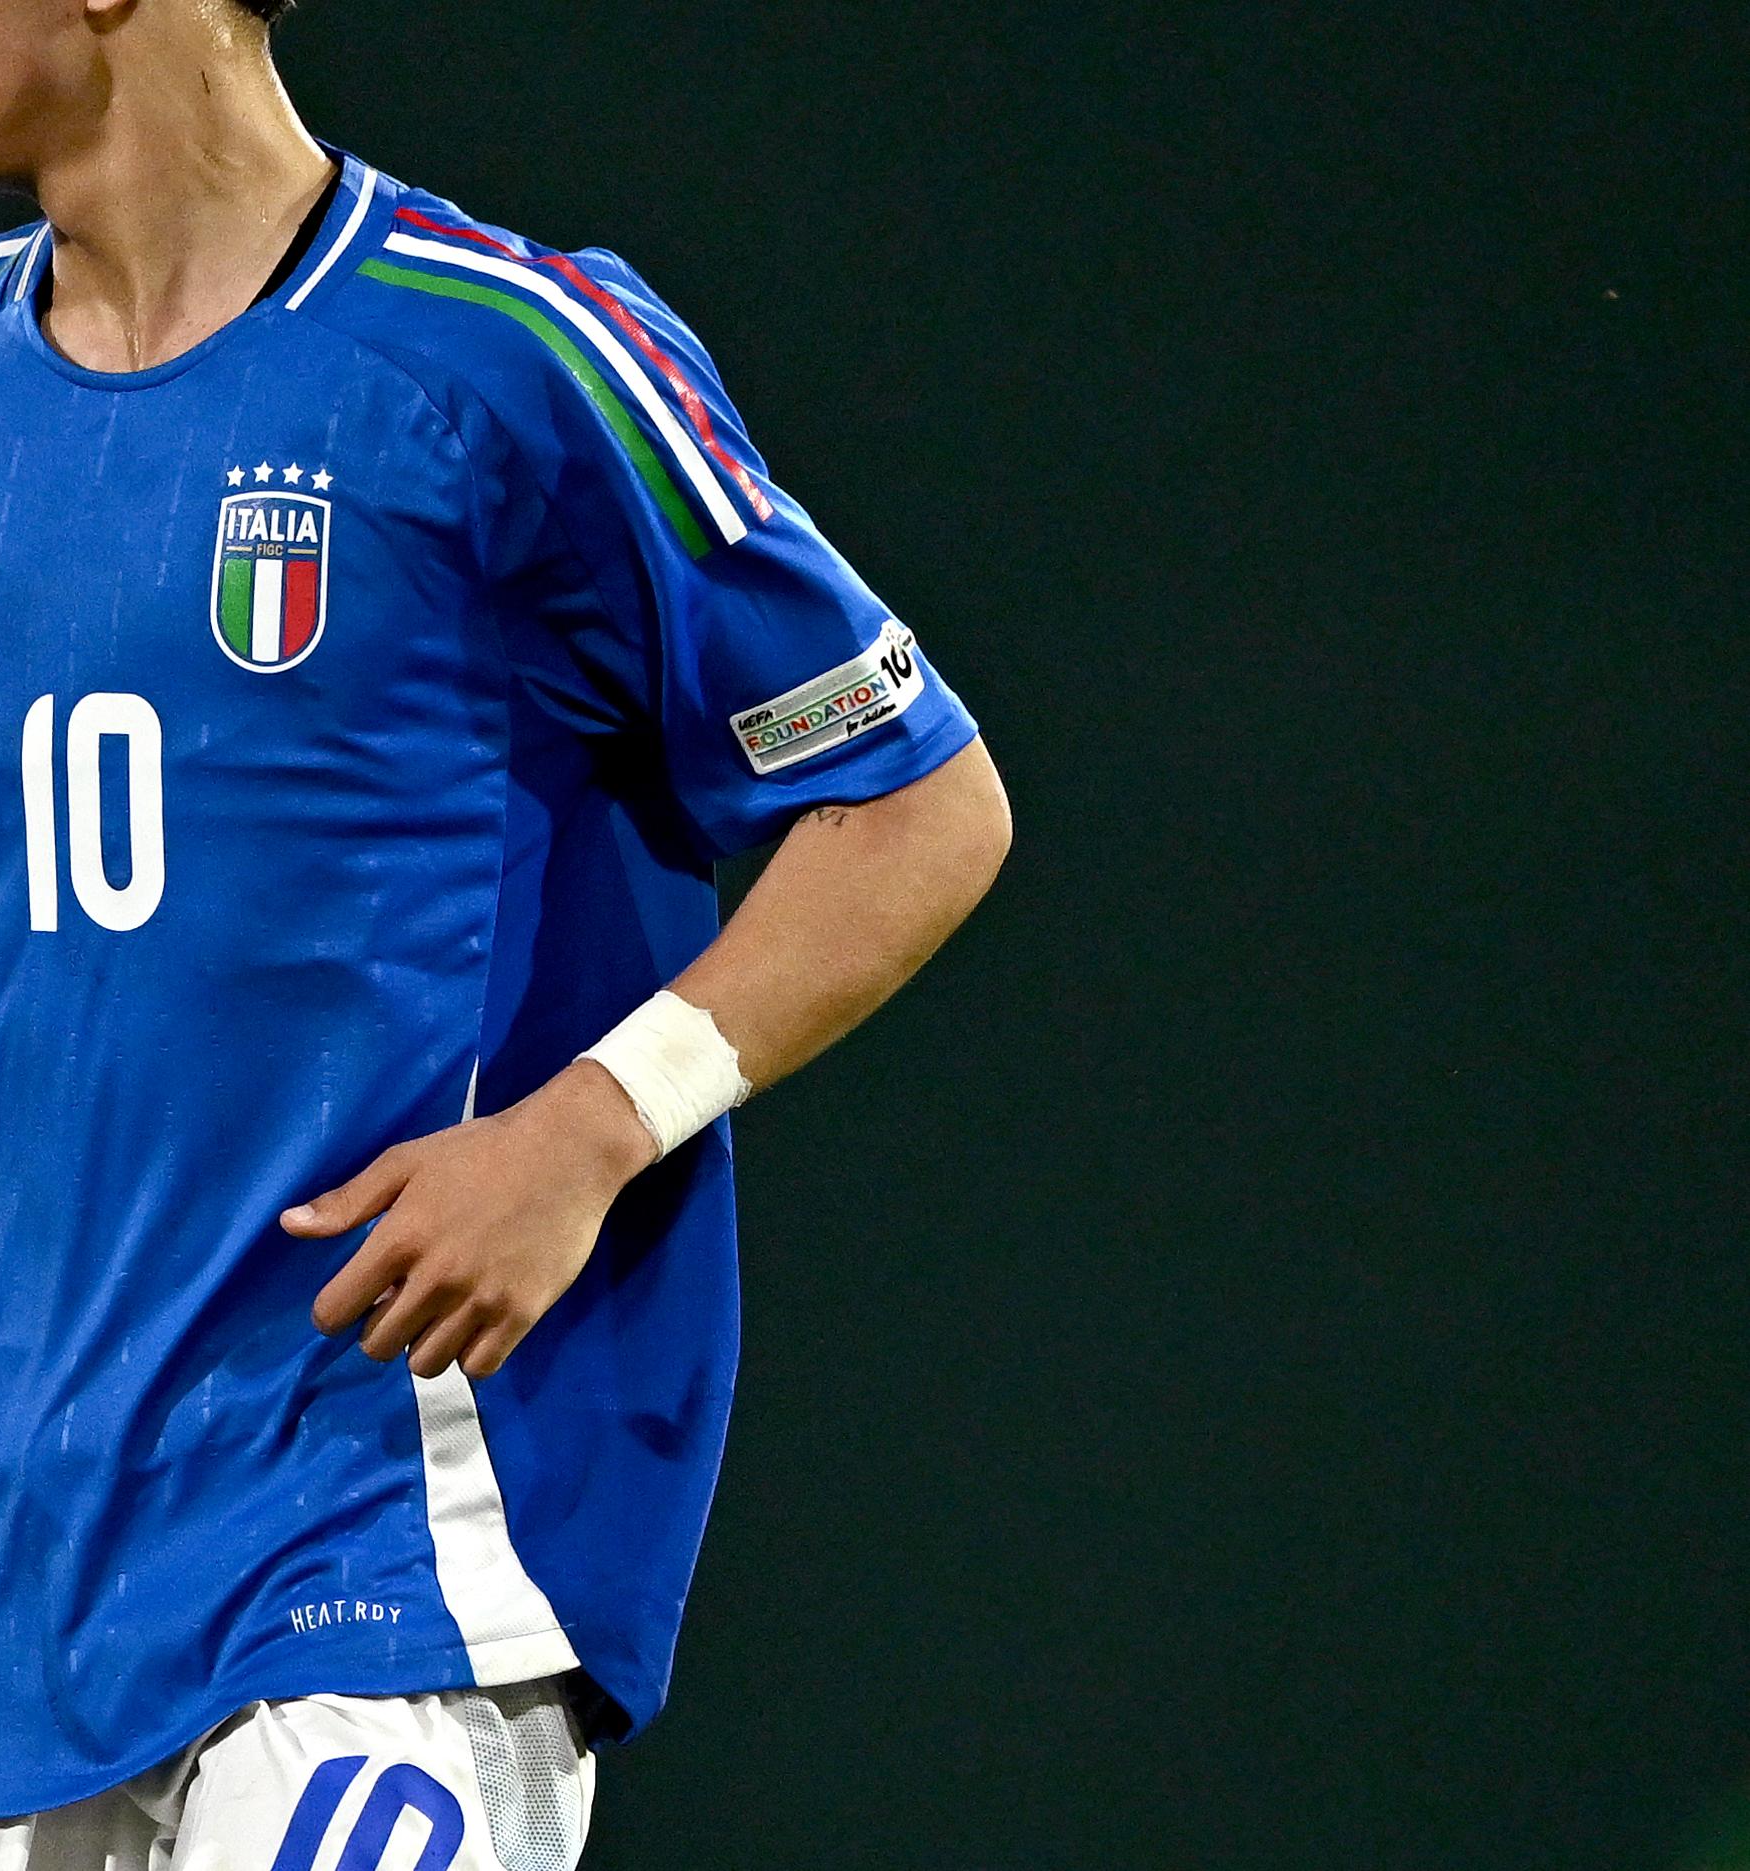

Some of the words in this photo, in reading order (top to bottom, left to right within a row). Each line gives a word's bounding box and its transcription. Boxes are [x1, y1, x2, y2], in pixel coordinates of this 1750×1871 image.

[226, 508, 319, 543] ITALIA
[256, 543, 284, 557] FIGC
[880, 644, 912, 689] 10
[738, 709, 774, 731] UEFA
[746, 677, 888, 751] FOUNDATION
[21, 692, 166, 932] 10
[290, 1600, 402, 1633] HEAT.RDY
